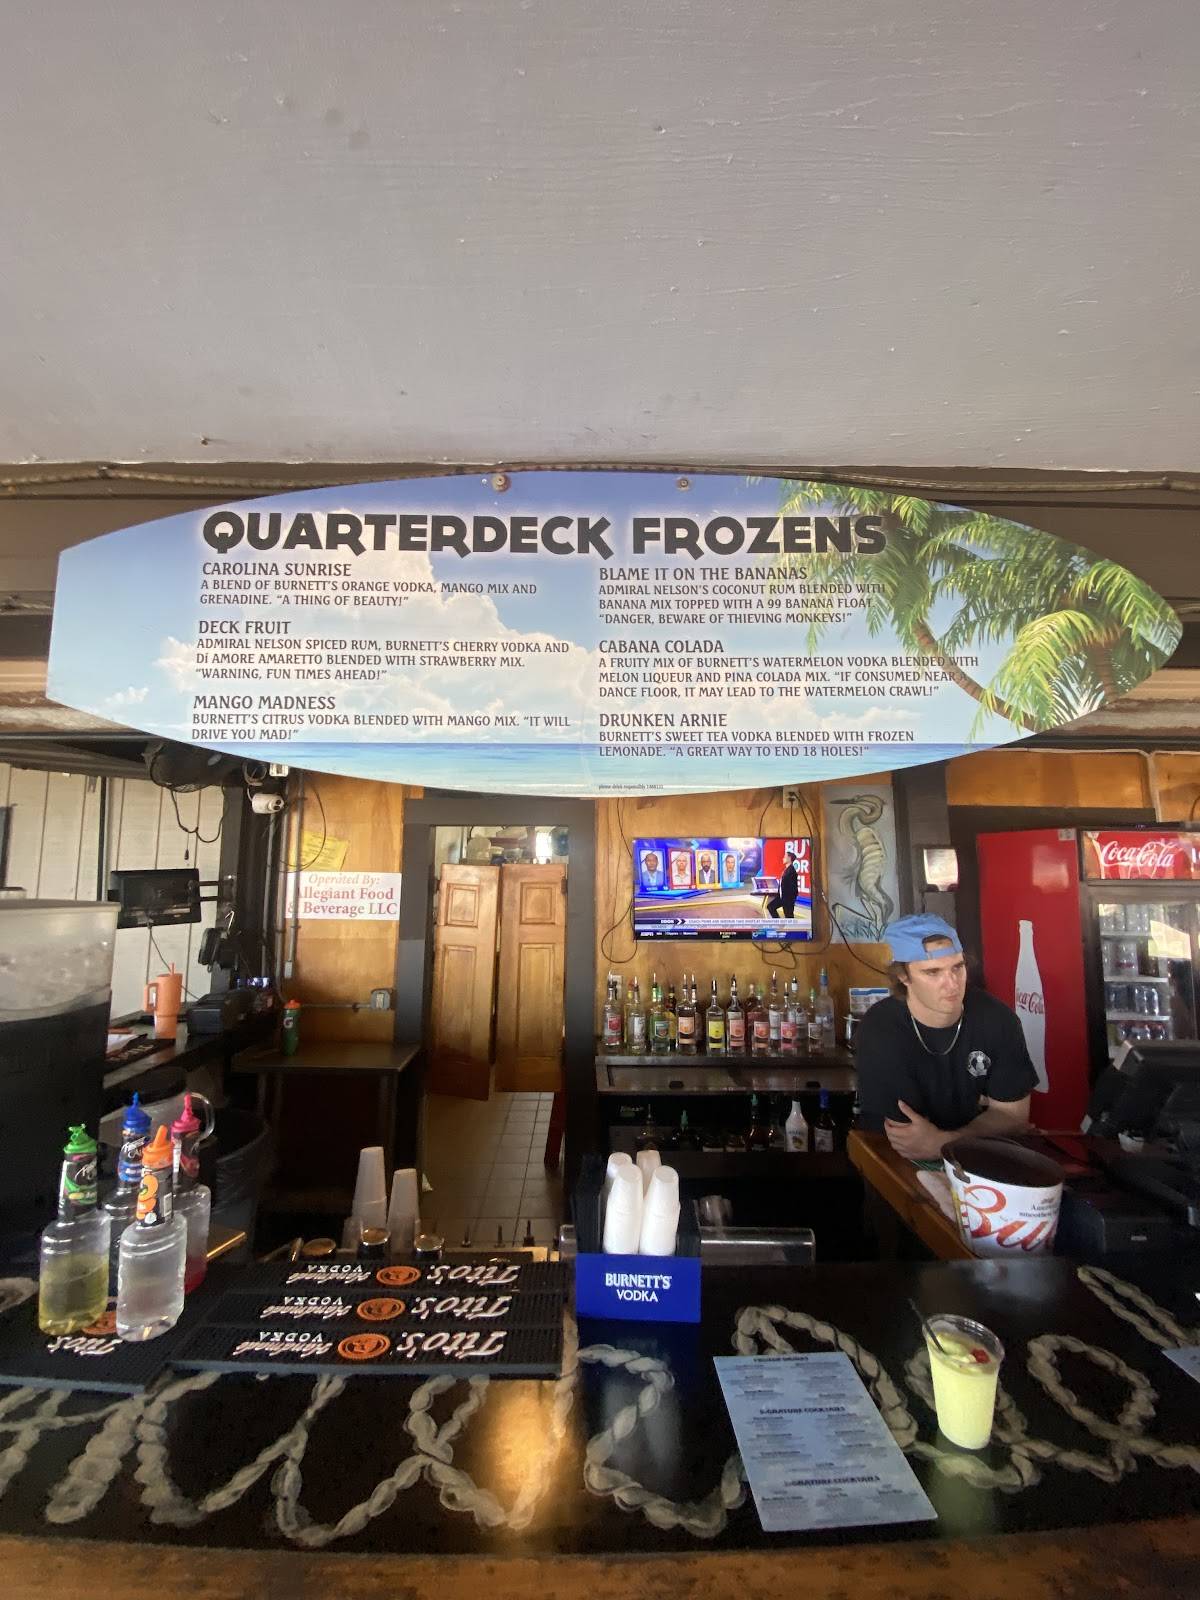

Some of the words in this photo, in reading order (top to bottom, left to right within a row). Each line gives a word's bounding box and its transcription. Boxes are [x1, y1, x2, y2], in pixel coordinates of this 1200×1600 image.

[203, 511, 615, 560] QUARTERDECK
[633, 515, 887, 560] FROZENS
[202, 562, 279, 576] CAROLINA
[284, 563, 350, 577] SUNRISE
[600, 567, 648, 581] BLAME
[655, 567, 667, 580] IT
[673, 567, 694, 580] ON
[700, 567, 728, 580] THE
[735, 567, 808, 580] BANANAS
[201, 580, 208, 591] A
[213, 580, 250, 591] BLEND
[254, 580, 269, 592] OF
[274, 580, 337, 592] BURNETT'S
[341, 581, 389, 593] ORANGE
[393, 581, 436, 593] VODKA,
[441, 582, 482, 594] MANGO
[487, 582, 508, 594] MIX
[512, 582, 536, 594] AND
[599, 584, 650, 595] ADMIRAL
[654, 584, 708, 595] NELSON'S
[712, 584, 765, 595] COCONUT
[769, 584, 795, 594] RUM
[799, 583, 851, 594] BLENDED
[855, 583, 885, 594] WITH
[200, 594, 271, 606] GRENADINE.
[294, 595, 329, 606] THING
[334, 595, 349, 606] OF
[599, 599, 646, 610] BANANA
[650, 599, 671, 610] MIX
[674, 598, 718, 610] TOPPED
[723, 598, 751, 609] WITH
[756, 598, 763, 609] A
[767, 598, 780, 609] 99
[785, 598, 833, 609] BANANA
[599, 613, 653, 625] "DANGER,
[658, 613, 705, 624] BEWARE
[709, 613, 723, 624] OF
[727, 613, 781, 624] THIEVING
[199, 620, 239, 634] DECK
[245, 621, 290, 634] FRUIT
[196, 639, 250, 650] ADMIRAL
[255, 639, 300, 650] NELSON
[305, 639, 346, 651] SPICED
[351, 640, 380, 651] RUM,
[386, 640, 449, 652] BURNETT'S
[453, 640, 497, 652] CHERRY
[501, 641, 540, 653] VODKA
[544, 641, 568, 653] AND
[599, 640, 659, 653] CABANA
[665, 640, 723, 653] COLADA
[212, 654, 254, 665] AMORE
[258, 654, 322, 666] AMARETTO
[326, 654, 381, 666] BLENDED
[385, 655, 415, 666] WITH
[419, 655, 496, 667] STRAWBERRY
[500, 656, 524, 668] MIX.
[598, 657, 606, 668] A
[610, 657, 649, 668] FRUITY
[653, 657, 674, 668] MIX
[677, 657, 692, 668] OF
[697, 657, 759, 668] BURNETT'S
[762, 656, 842, 668] WATERMELON
[847, 656, 887, 668] VODKA
[891, 656, 944, 667] BLENDED
[949, 656, 977, 667] WITH
[196, 669, 261, 680] "WARNING,
[266, 669, 290, 680] FUN
[296, 669, 330, 681] TIMES
[599, 672, 638, 683] MELON
[643, 671, 692, 683] LIQUEUR
[696, 671, 720, 683] AND
[724, 671, 752, 683] PINA
[756, 671, 800, 683] COLADA
[805, 671, 829, 683] MIX.
[855, 671, 920, 683] CONSUMED
[924, 671, 956, 682] NEAR
[599, 686, 636, 698] DANCE
[641, 686, 680, 698] FLOOR,
[685, 686, 695, 698] IT
[699, 686, 723, 698] MAY
[727, 686, 755, 698] LEAD
[759, 686, 774, 697] TO
[777, 686, 800, 697] THE
[804, 686, 884, 697] WATERMELON
[193, 696, 252, 710] MANGO
[258, 696, 335, 710] MADNESS
[193, 714, 257, 725] BURNETT'S
[262, 714, 304, 726] CITRUS
[308, 715, 349, 726] VODKA
[354, 715, 408, 726] BLENDED
[412, 715, 442, 726] WITH
[447, 715, 490, 727] MANGO
[494, 715, 518, 727] MIX.
[543, 715, 569, 727] WILL
[600, 713, 674, 727] DRUNKEN
[680, 713, 726, 727] ARNIE
[192, 729, 227, 740] DRIVE
[231, 729, 255, 740] YOU
[599, 731, 661, 742] BURNETT'S
[665, 731, 702, 742] SWEET
[706, 731, 727, 742] TEA
[731, 731, 771, 742] VODKA
[776, 731, 829, 742] BLENDED
[833, 730, 863, 742] WITH
[868, 730, 913, 742] FROZEN
[599, 746, 665, 757] LEMONADE.
[687, 746, 723, 757] GREAT
[727, 746, 752, 757] WAY
[755, 746, 770, 757] TO
[774, 746, 798, 757] END
[803, 746, 816, 757] 18
[785, 839, 810, 858] BU
[1100, 841, 1177, 867] Coca-Cola
[308, 873, 359, 886] Operated
[362, 874, 380, 887] By:
[360, 887, 394, 900] Food
[303, 901, 365, 918] Beverage
[368, 902, 398, 915] LLC
[307, 1265, 363, 1273] VODKA
[286, 1270, 371, 1284] Handmade
[605, 1272, 672, 1289] BURNETT'S
[284, 1296, 343, 1306] VODKA
[616, 1289, 659, 1302] VODKA
[260, 1305, 352, 1320] Handmade
[259, 1331, 323, 1343] VODKA
[232, 1339, 333, 1358] Handmade
